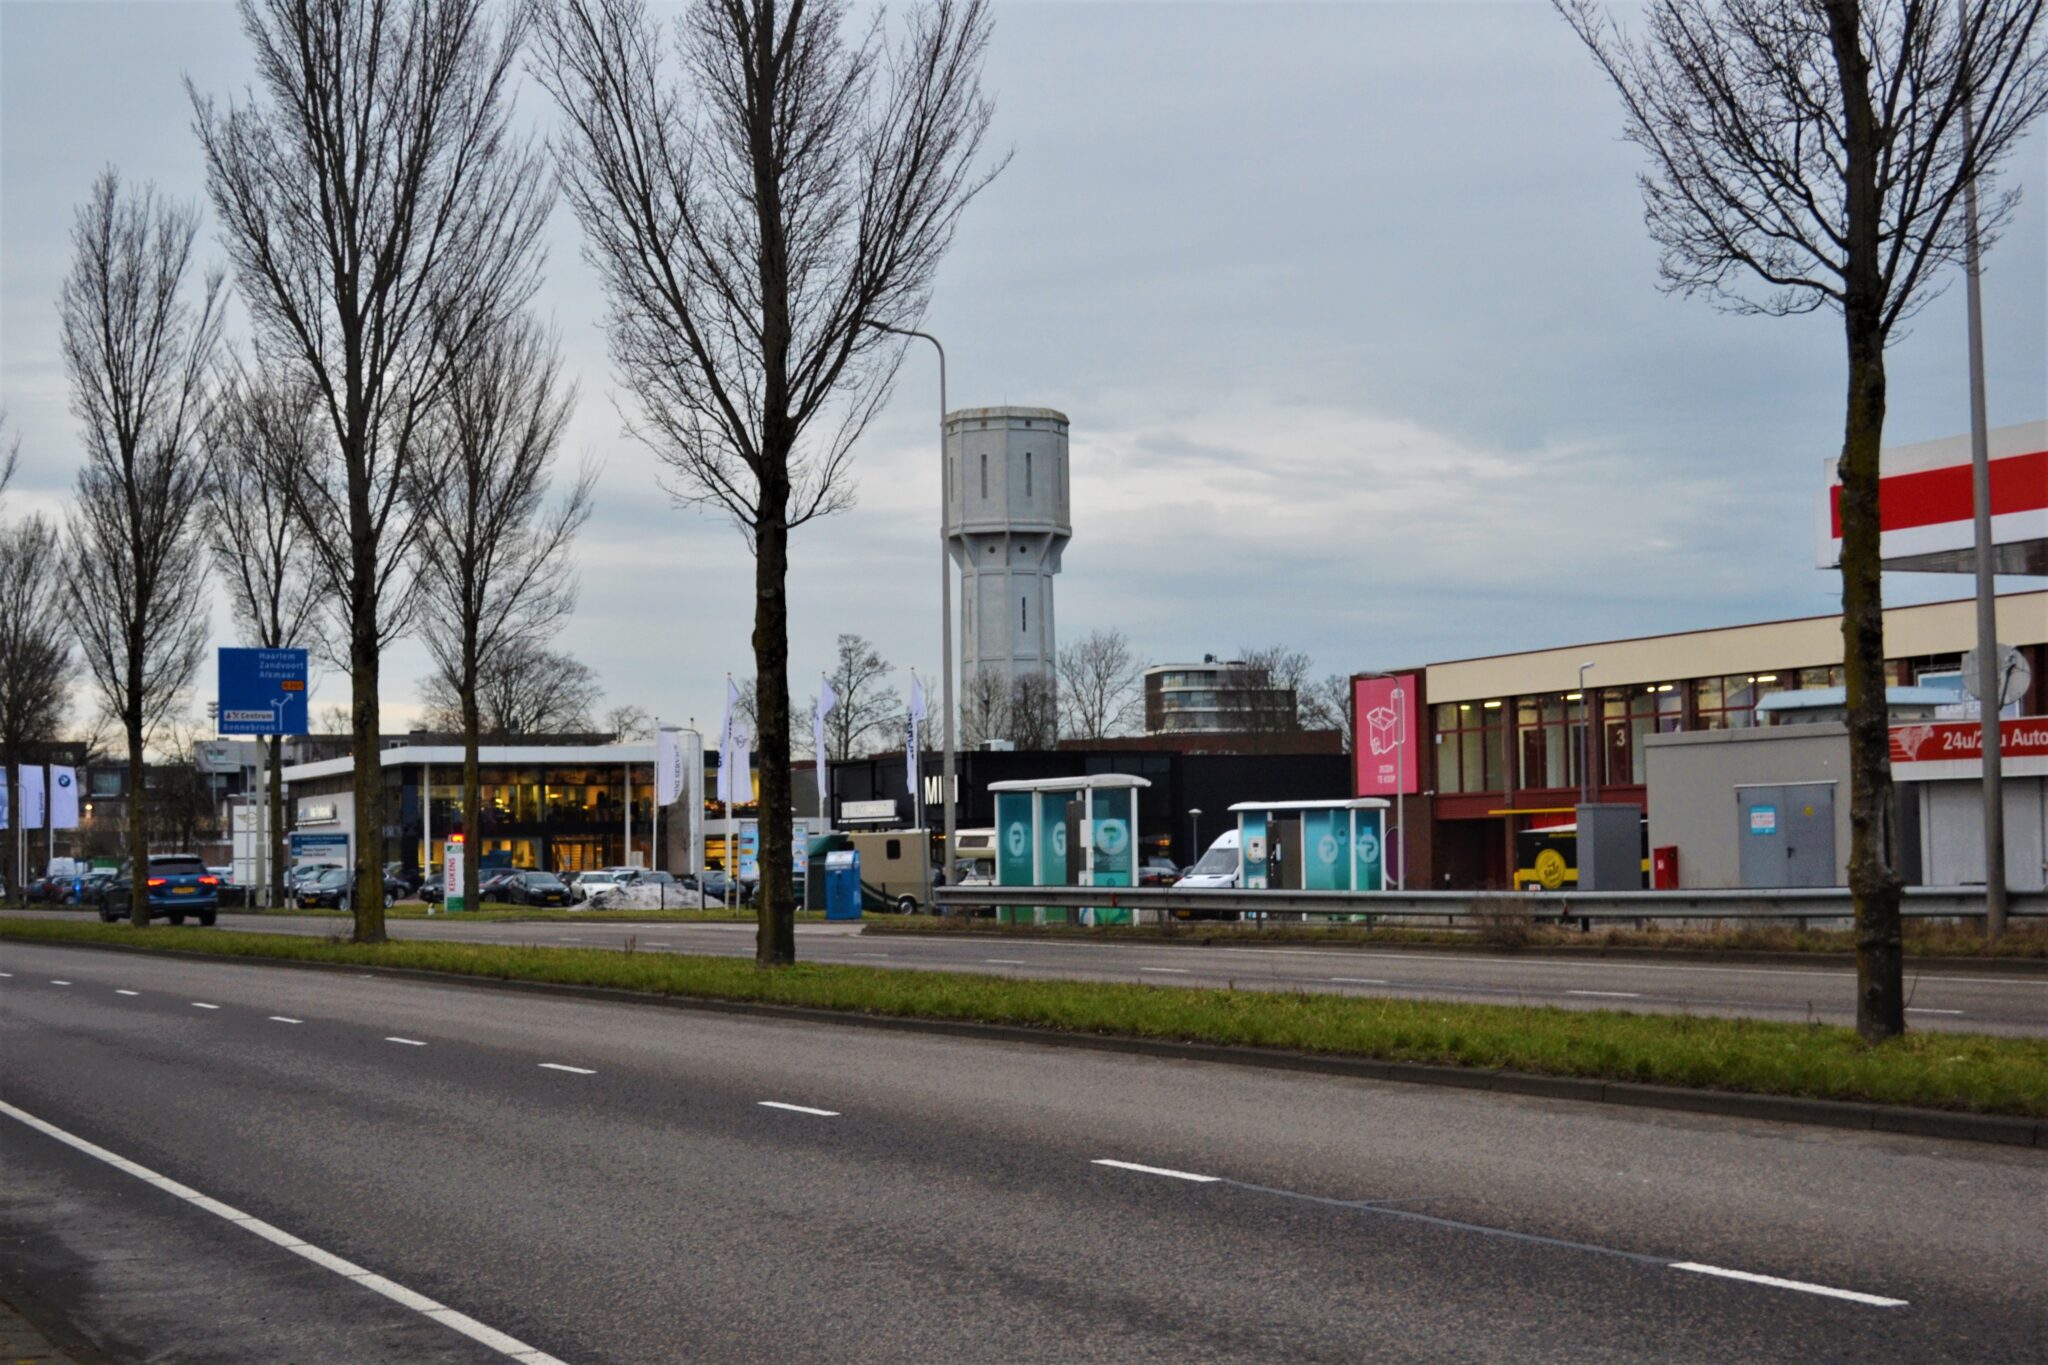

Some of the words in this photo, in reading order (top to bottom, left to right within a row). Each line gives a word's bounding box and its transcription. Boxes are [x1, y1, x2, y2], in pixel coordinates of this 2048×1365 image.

[259, 652, 295, 660] Haarlem
[223, 723, 276, 731] Bennebroek
[1616, 729, 1625, 746] 3
[1943, 731, 2005, 750] 24u/2u
[924, 774, 958, 804] MII
[448, 858, 456, 892] KEUKENS
